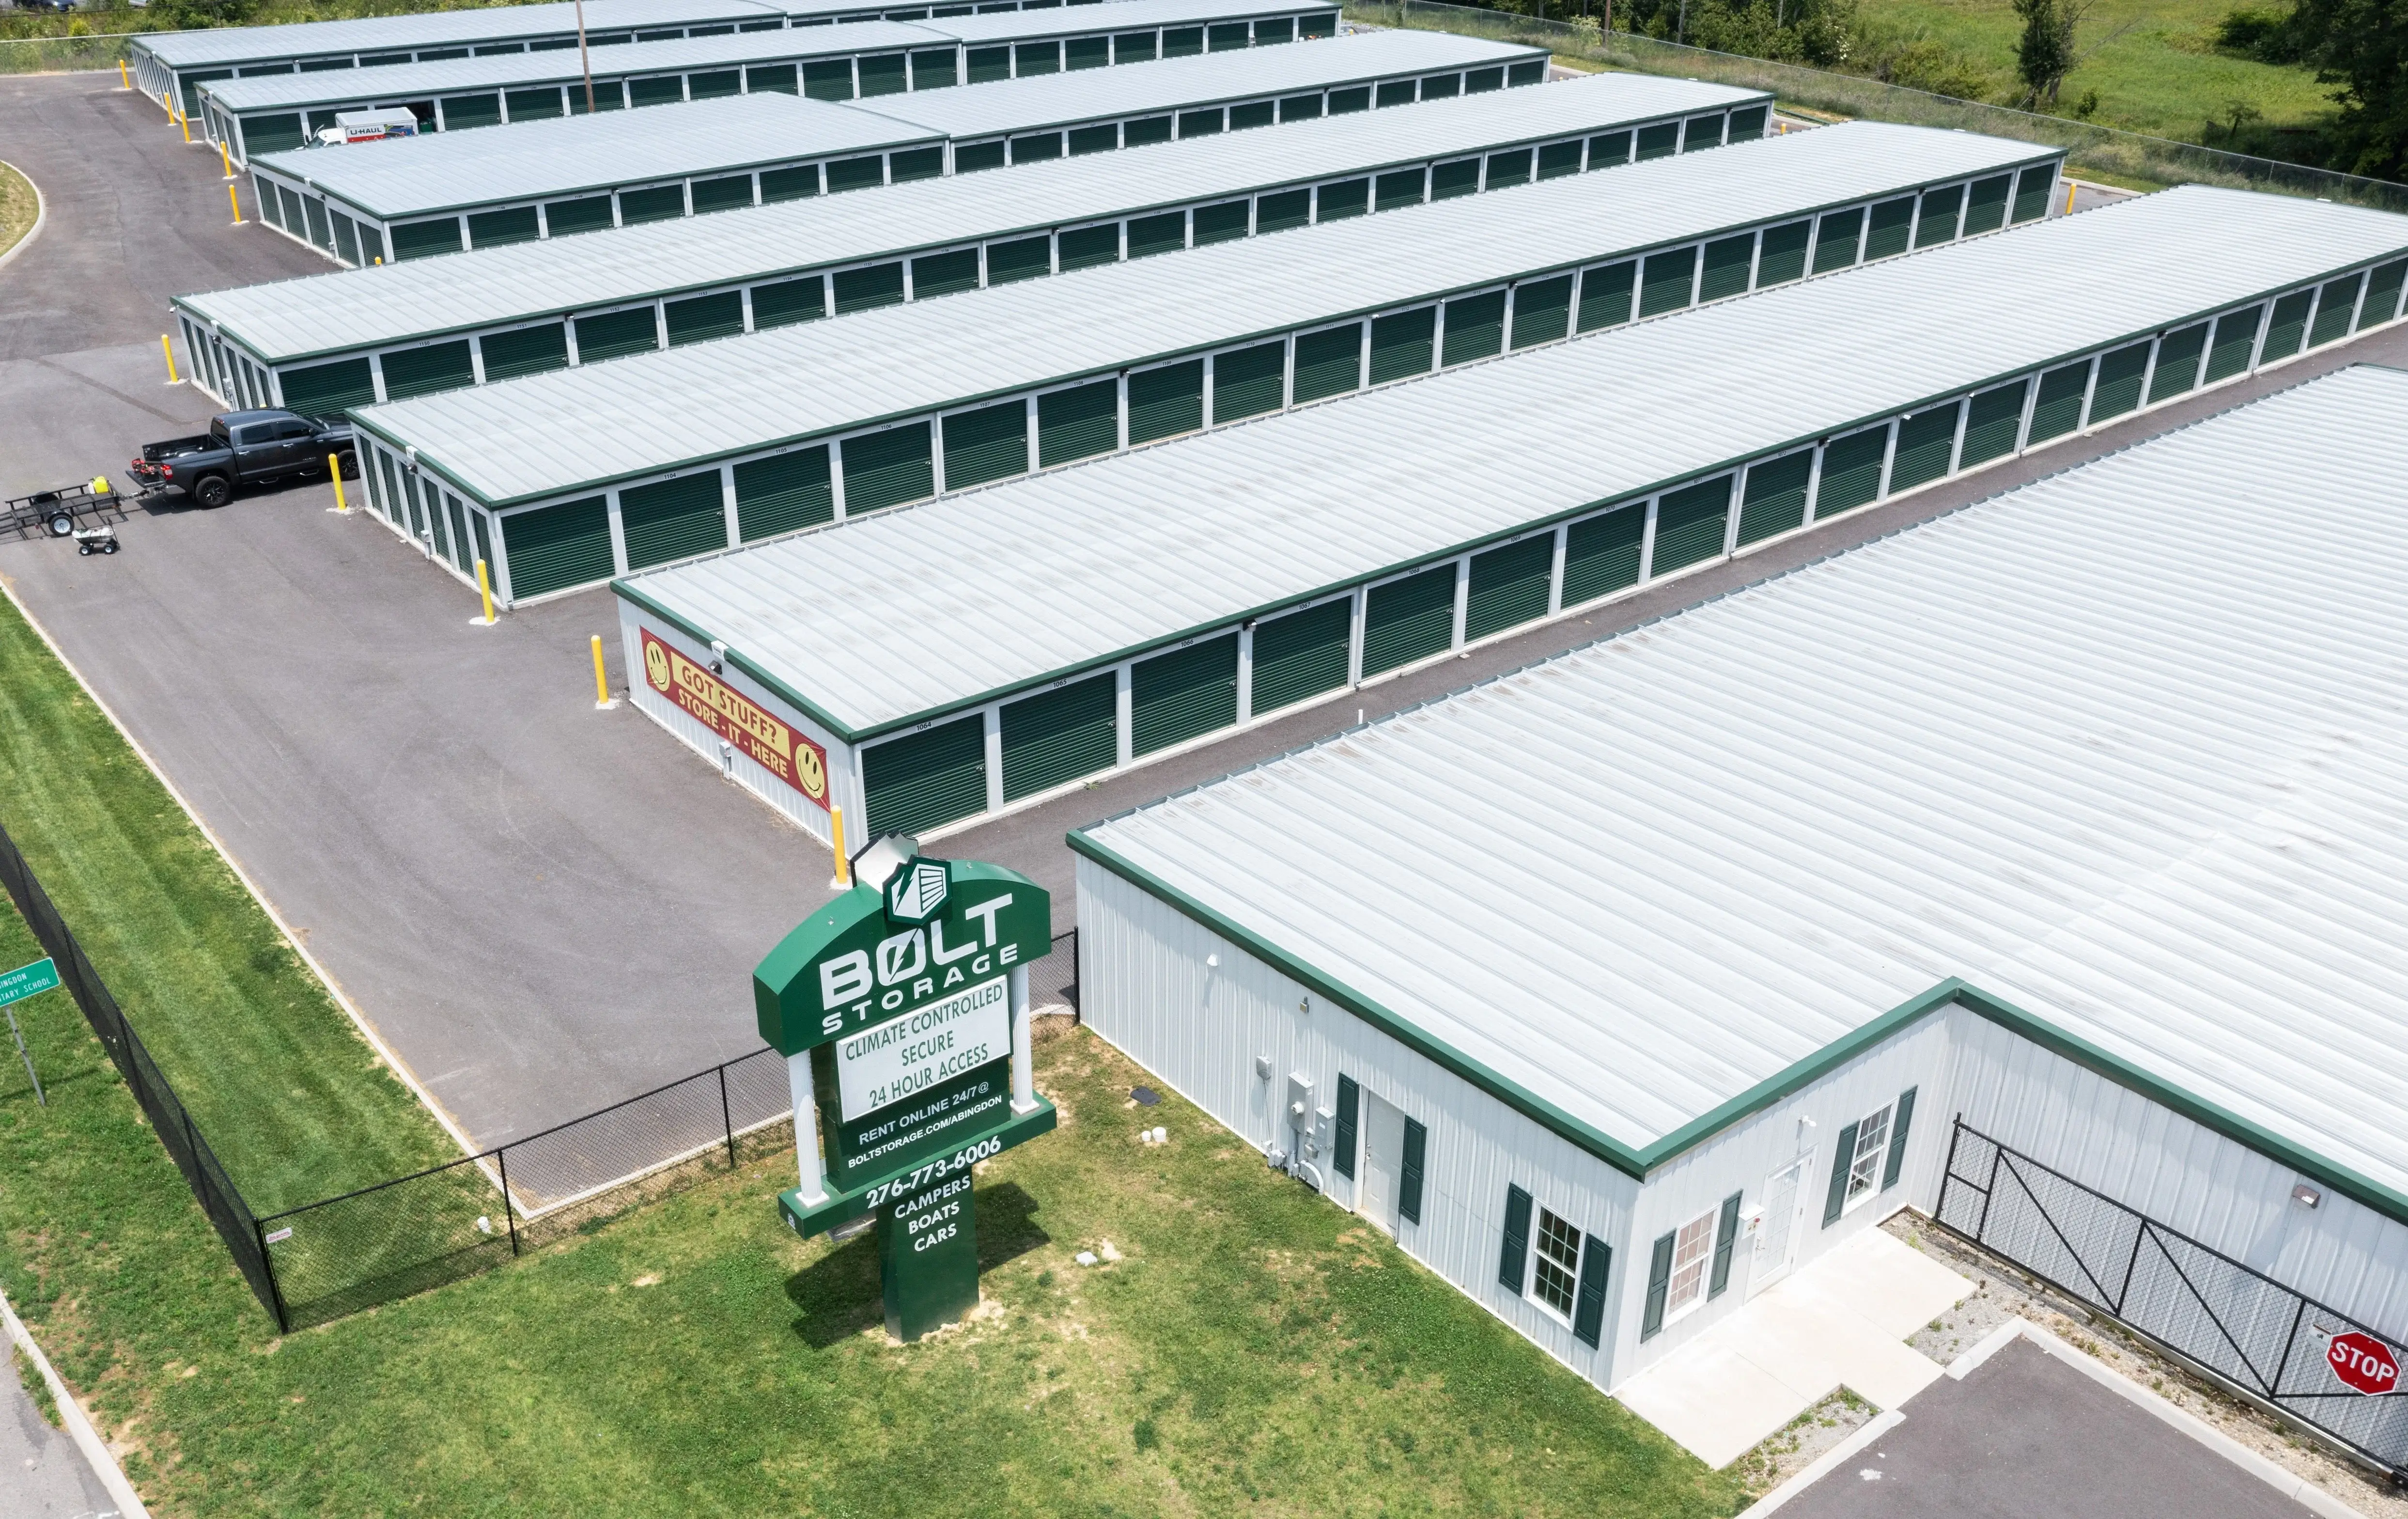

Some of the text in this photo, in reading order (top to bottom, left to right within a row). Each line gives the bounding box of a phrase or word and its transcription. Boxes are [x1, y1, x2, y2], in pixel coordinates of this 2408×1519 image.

[1299, 602, 1311, 610] 1067
[1181, 639, 1194, 647] 1066
[1053, 679, 1067, 688] 1065
[682, 665, 777, 743] GOT STUFF?
[679, 689, 718, 727] STORE
[751, 738, 788, 778] HERE
[917, 721, 932, 731] 1064
[0, 973, 27, 989] INGDON
[24, 977, 51, 992] SCHOOL
[823, 943, 1017, 1035] STORAGE
[846, 985, 1002, 1061] CLIMATE CONTROLLED
[901, 1030, 954, 1066] SECURE
[870, 1043, 988, 1108] 24 HOUR ACCESS
[848, 1095, 1002, 1168] BOLTSTORAGE.COM/ABINGDON
[859, 1121, 896, 1145] RENT
[899, 1098, 948, 1127] ONLINE
[866, 1135, 1001, 1209] 276-773-6006
[895, 1175, 970, 1218] CAMPERS
[909, 1201, 960, 1234] BOATS
[914, 1223, 957, 1252] CARS
[2331, 1342, 2394, 1382] STOP
